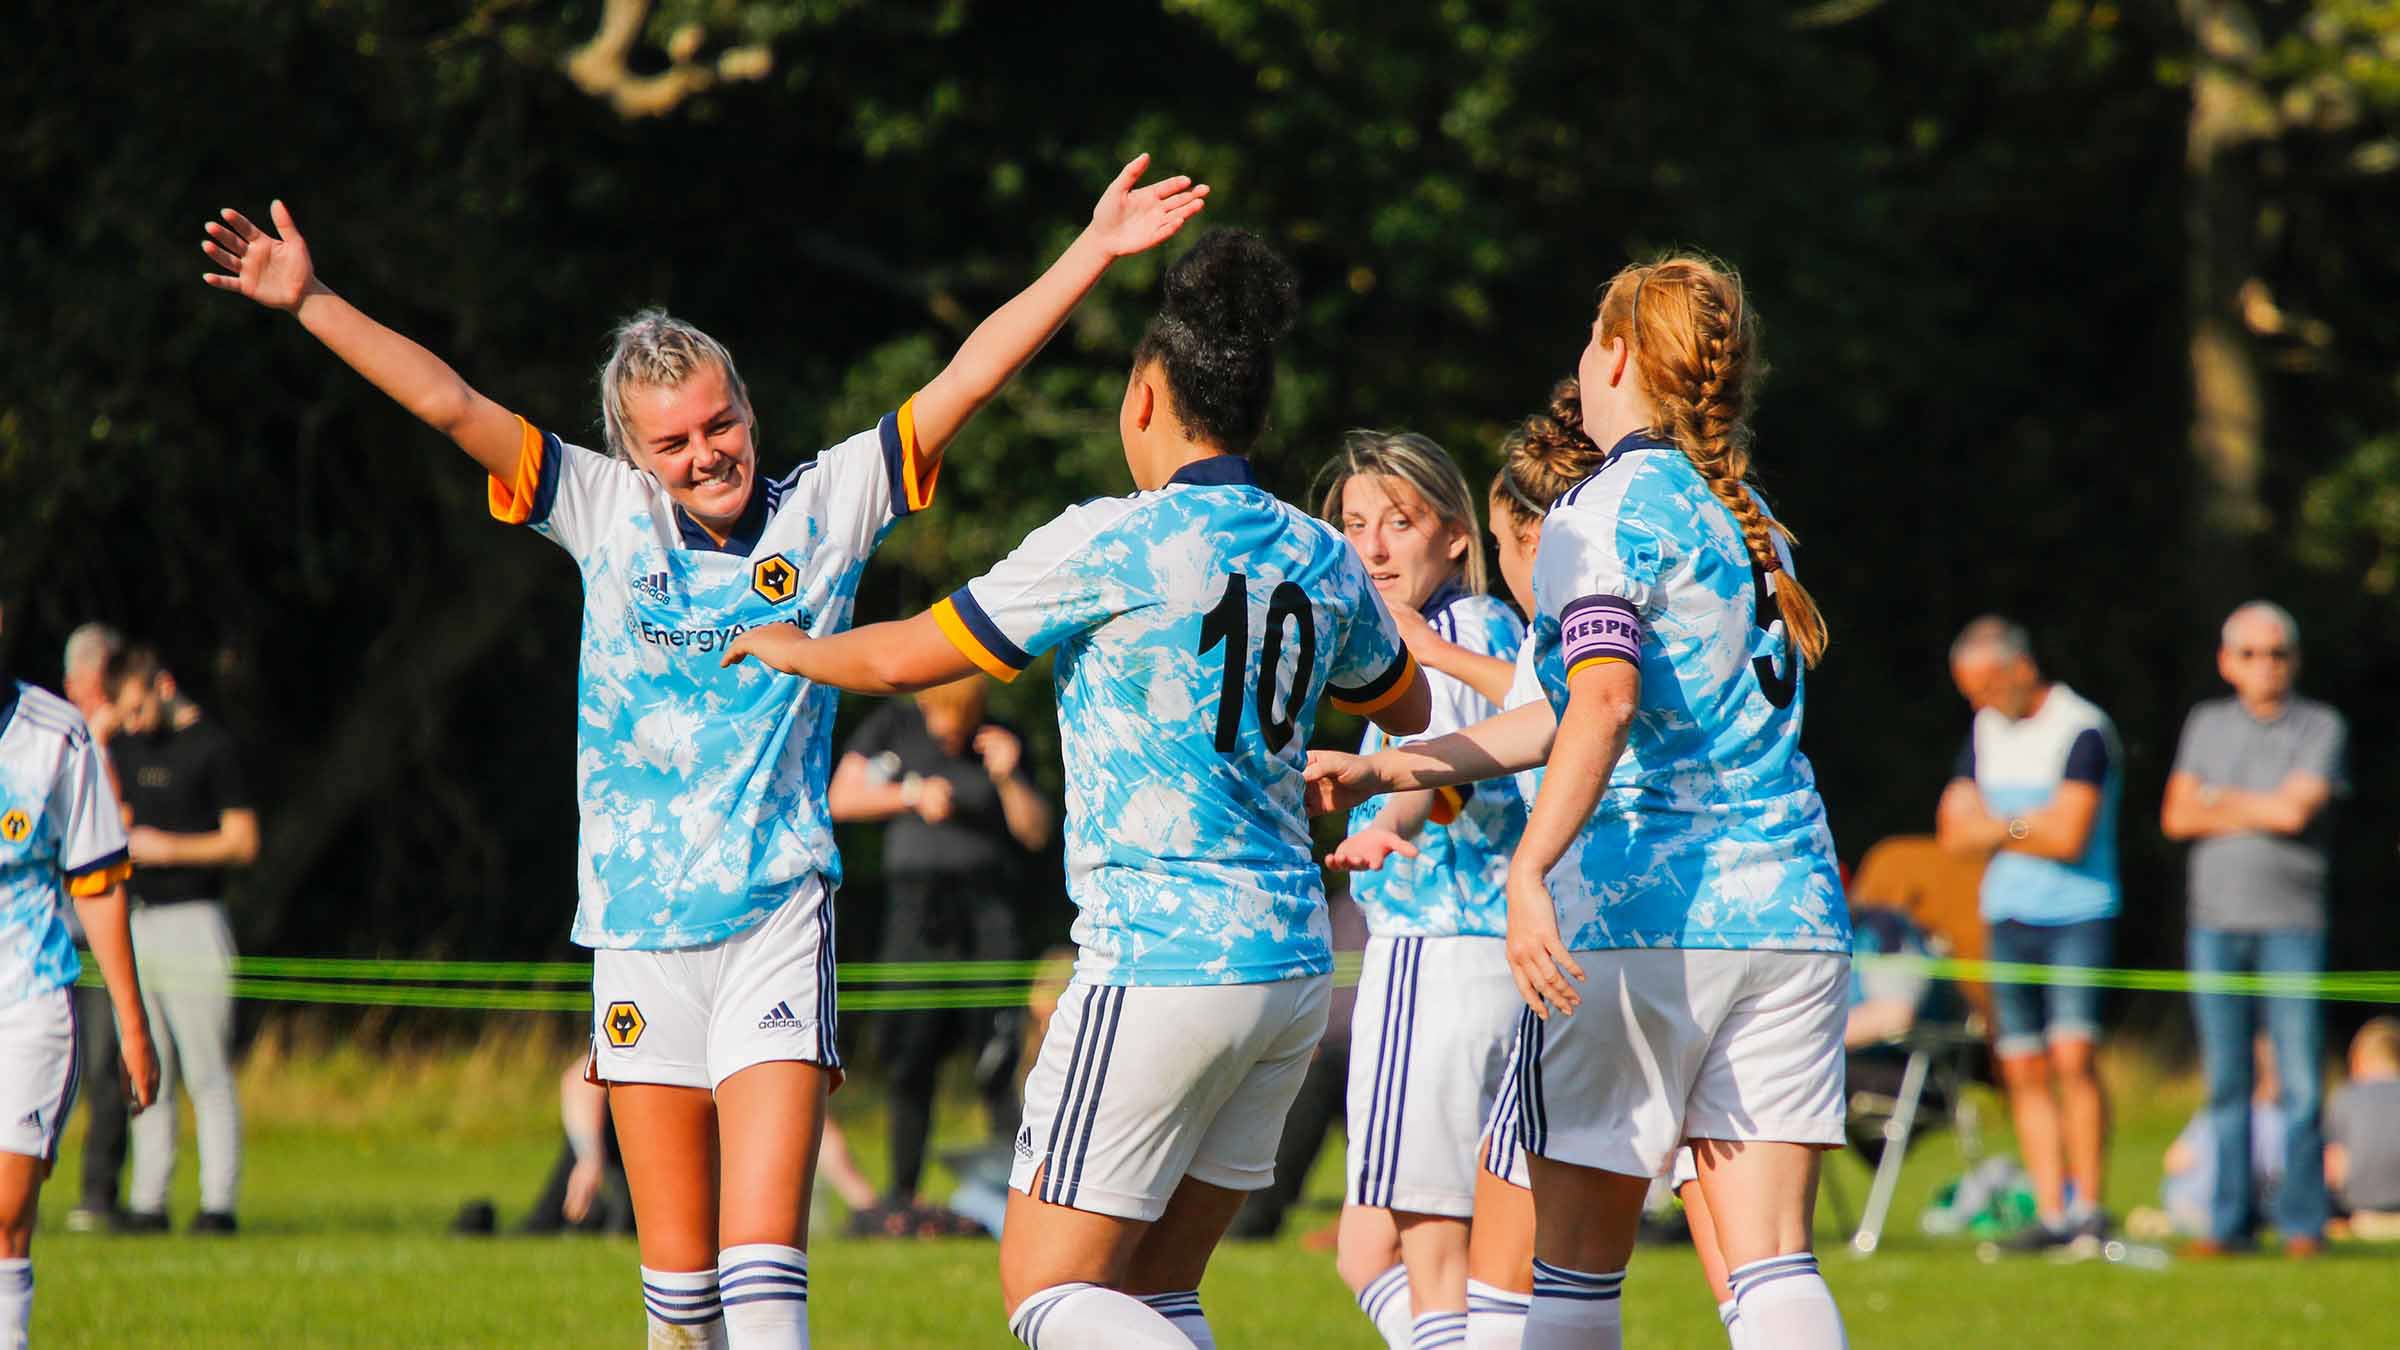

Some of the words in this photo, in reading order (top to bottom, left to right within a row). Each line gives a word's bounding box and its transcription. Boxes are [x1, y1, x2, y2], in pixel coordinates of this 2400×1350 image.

[632, 579, 670, 606] adidas
[643, 609, 812, 652] EnergyAls
[1198, 572, 1315, 755] 10
[758, 1018, 802, 1030] adidas
